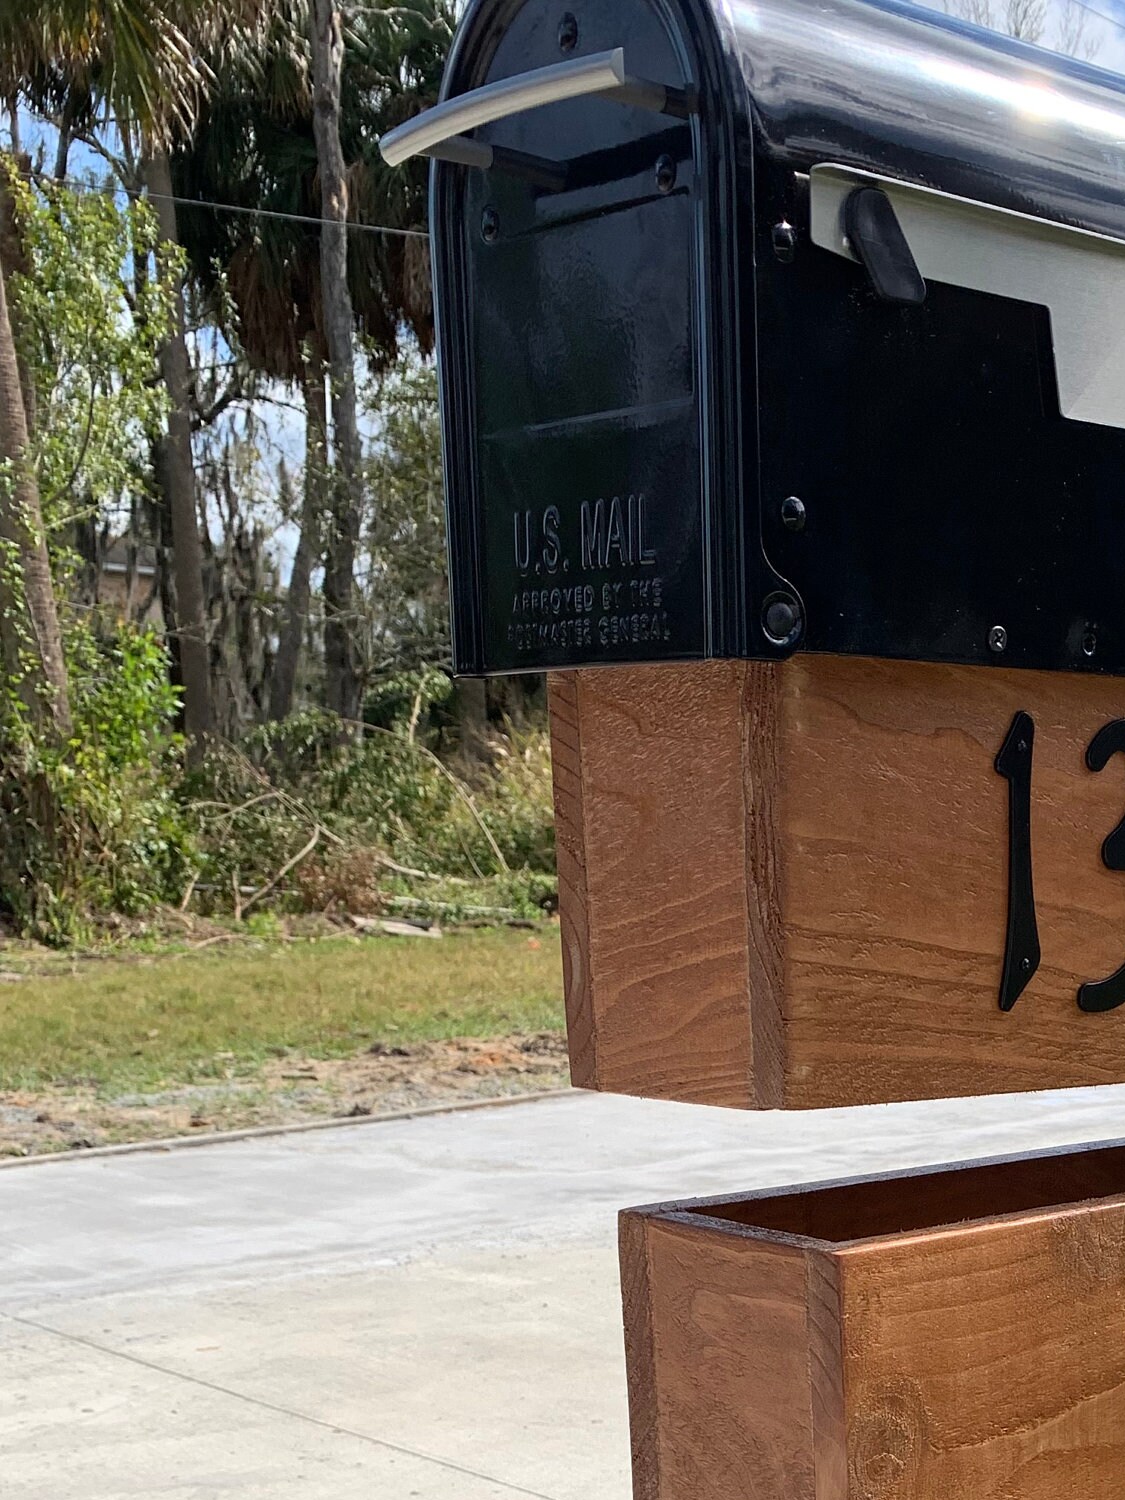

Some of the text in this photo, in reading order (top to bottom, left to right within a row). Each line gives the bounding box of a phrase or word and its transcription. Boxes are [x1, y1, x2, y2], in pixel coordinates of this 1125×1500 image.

[513, 493, 657, 577] U.S. MAIL
[512, 583, 595, 614] APPROVED
[601, 582, 623, 611] BY
